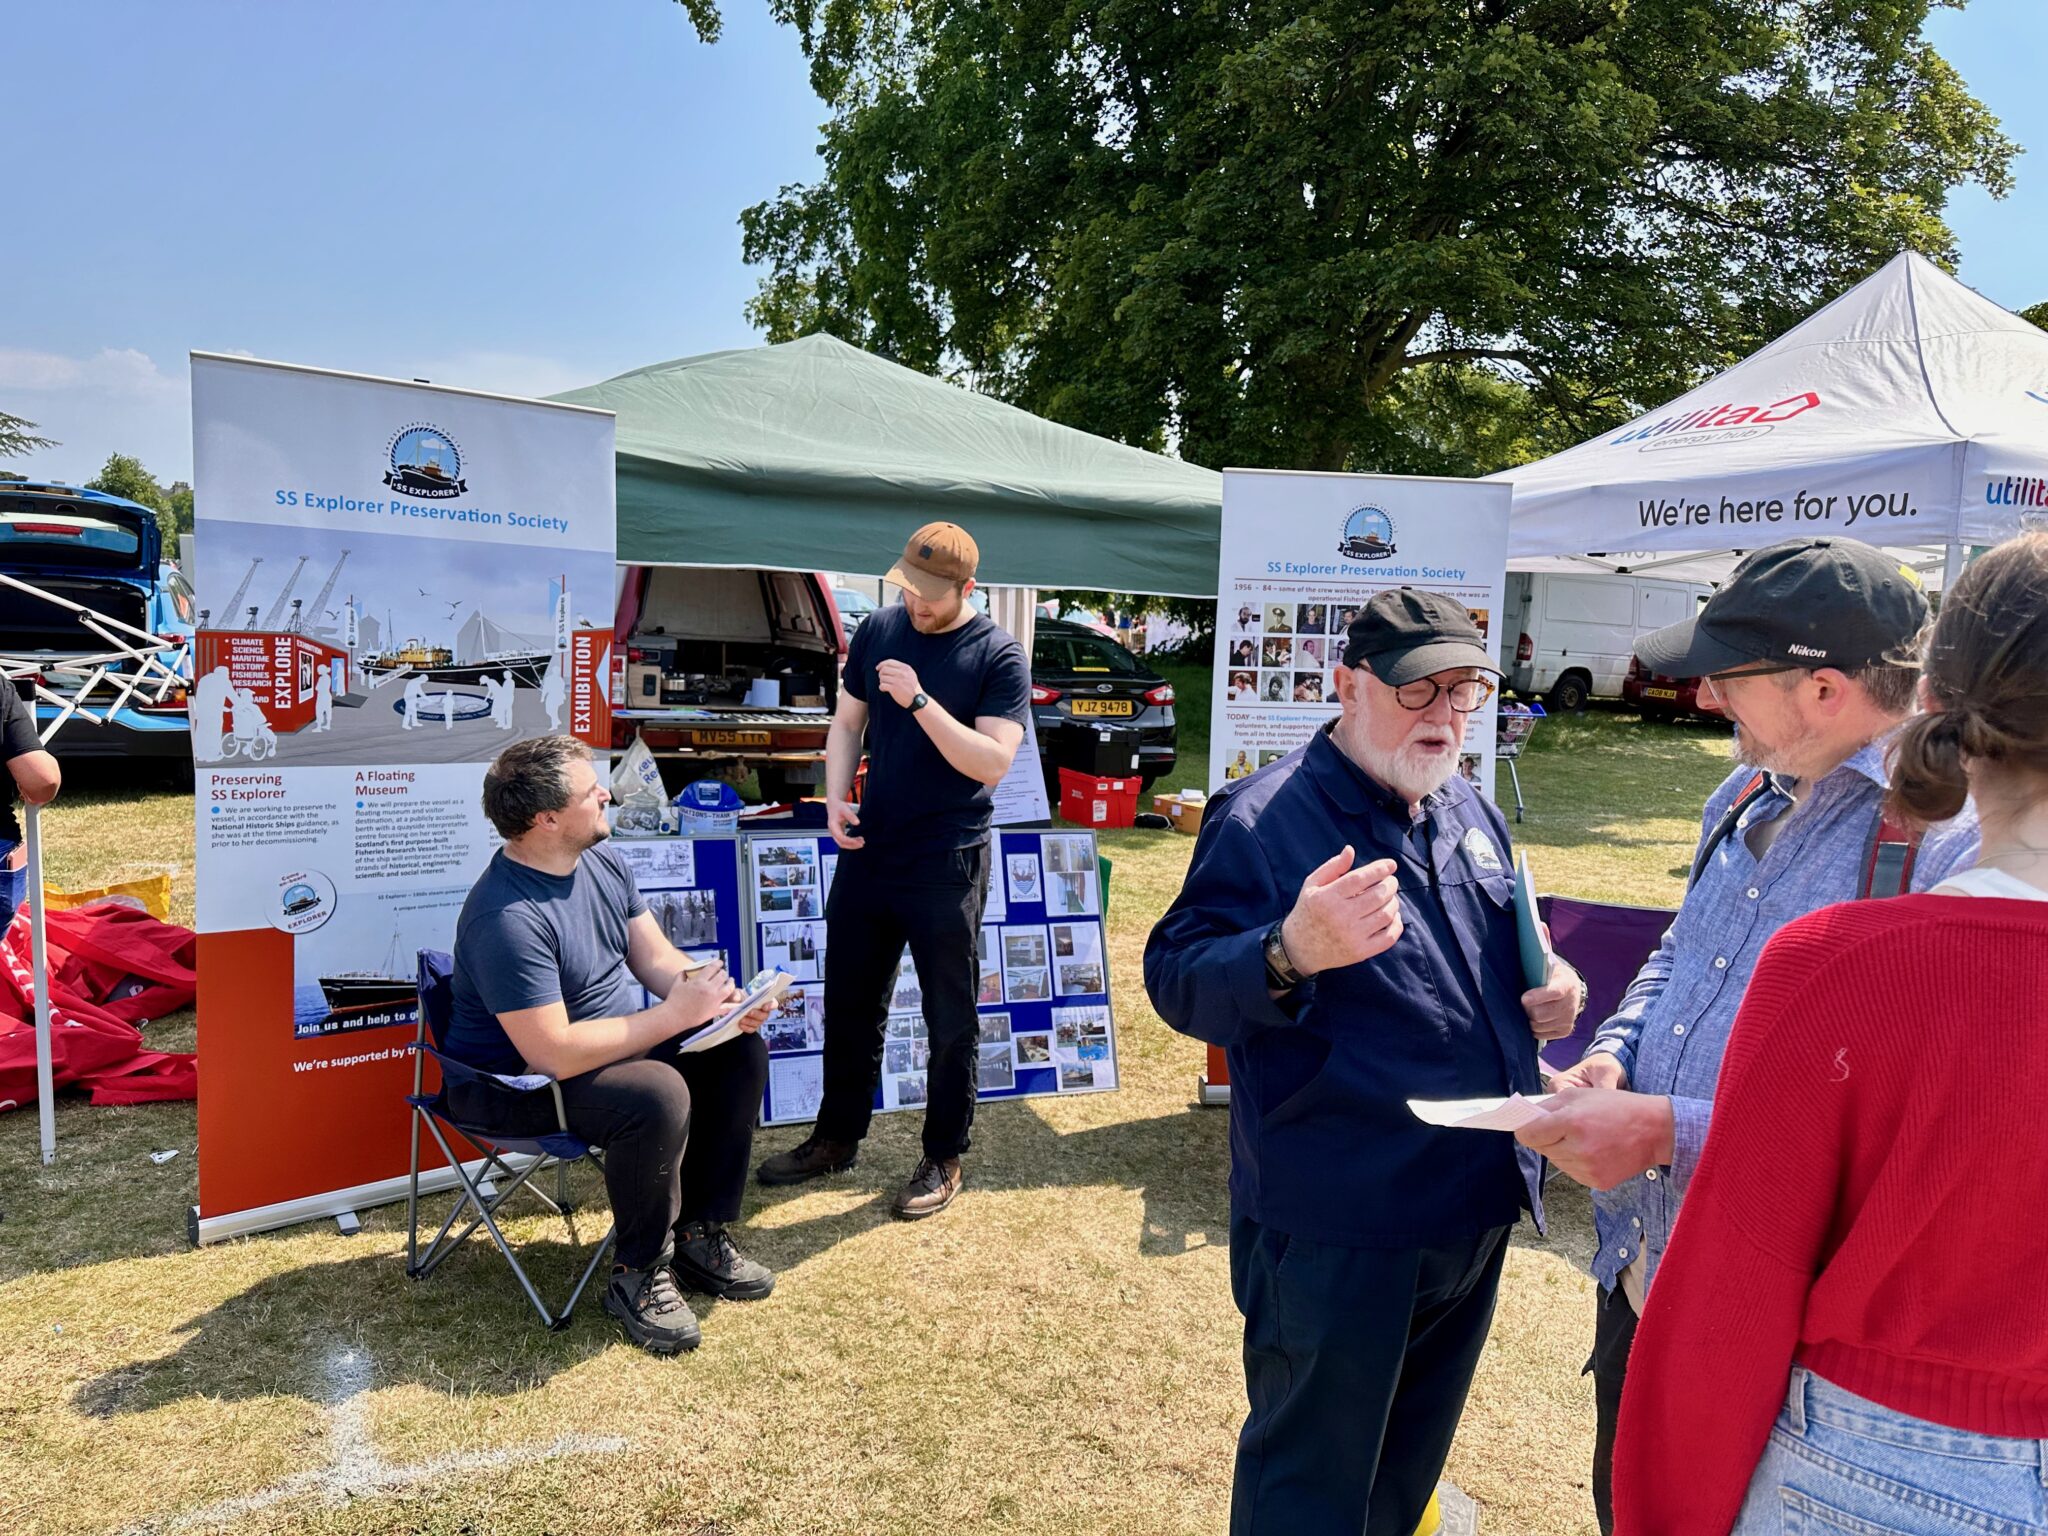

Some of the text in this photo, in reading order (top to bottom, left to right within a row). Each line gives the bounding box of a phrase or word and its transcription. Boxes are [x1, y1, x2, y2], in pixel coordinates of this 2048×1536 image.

[1610, 403, 1760, 445] utilita
[396, 483, 455, 497] SS EXPLORER
[1986, 476, 2048, 507] utilit
[275, 490, 568, 534] SS Explorer Preservation Society
[1638, 489, 1917, 527] We're here for you.
[1267, 562, 1466, 581] SS Explorer Preservation Society
[1234, 583, 1252, 591] 1956
[1334, 587, 1360, 595] working
[1308, 595, 1342, 603] operational
[231, 638, 264, 646] CLIMATE
[232, 646, 264, 654] SCIENCE
[1787, 643, 1827, 658] Nikon
[231, 655, 270, 663] MARITIME
[231, 671, 270, 679] FISHERIES
[275, 637, 291, 709] EXPLORE
[232, 679, 272, 687] RESEARCH
[575, 636, 591, 733] EXHIBITION
[1077, 701, 1128, 713] YJZ 9478
[1235, 722, 1267, 730] volunteers,
[1282, 723, 1315, 731] supporters
[211, 773, 282, 787] Preserving
[355, 770, 415, 782] A Floating
[211, 788, 286, 801] SS Explorer
[355, 785, 408, 796] Museum
[253, 804, 282, 814] working
[283, 804, 292, 812] to
[293, 804, 323, 813] preserve
[380, 800, 392, 808] will
[393, 801, 418, 809] prepare
[431, 798, 451, 806] vessel
[211, 815, 236, 824] vessel,
[247, 813, 288, 822] accordance
[289, 811, 305, 819] with
[355, 809, 381, 817] floating
[355, 816, 394, 825] destination,
[409, 814, 434, 823] publicly
[435, 813, 467, 821] accessible
[211, 821, 244, 831] National
[246, 820, 274, 830] Historic
[275, 820, 295, 829] Ships
[296, 819, 330, 828] guidance,
[355, 821, 469, 833] berth with quayside interpretative
[265, 829, 283, 837] time
[283, 827, 328, 836] immediately
[378, 831, 408, 840] focussing
[211, 840, 230, 849] prior
[355, 840, 389, 848] Scotland's
[390, 839, 404, 847] first
[355, 848, 385, 856] Fisheries
[386, 846, 417, 854] Research
[417, 845, 440, 853] Vessel.
[454, 843, 470, 851] story
[376, 855, 390, 864] ship
[404, 853, 432, 861] embrace
[433, 852, 451, 860] many
[355, 864, 380, 872] strands
[389, 861, 421, 870] historical,
[422, 859, 462, 867] engineering,
[355, 871, 385, 880] scientific
[420, 867, 447, 875] interest.
[287, 910, 327, 929] EXPLORER
[297, 1024, 320, 1035] Join
[324, 1022, 338, 1031] us
[342, 1016, 363, 1029] and
[367, 1013, 390, 1025] help
[394, 1012, 406, 1021] to
[293, 1059, 328, 1072] We're
[331, 1048, 389, 1067] supported
[391, 1047, 405, 1059] by
